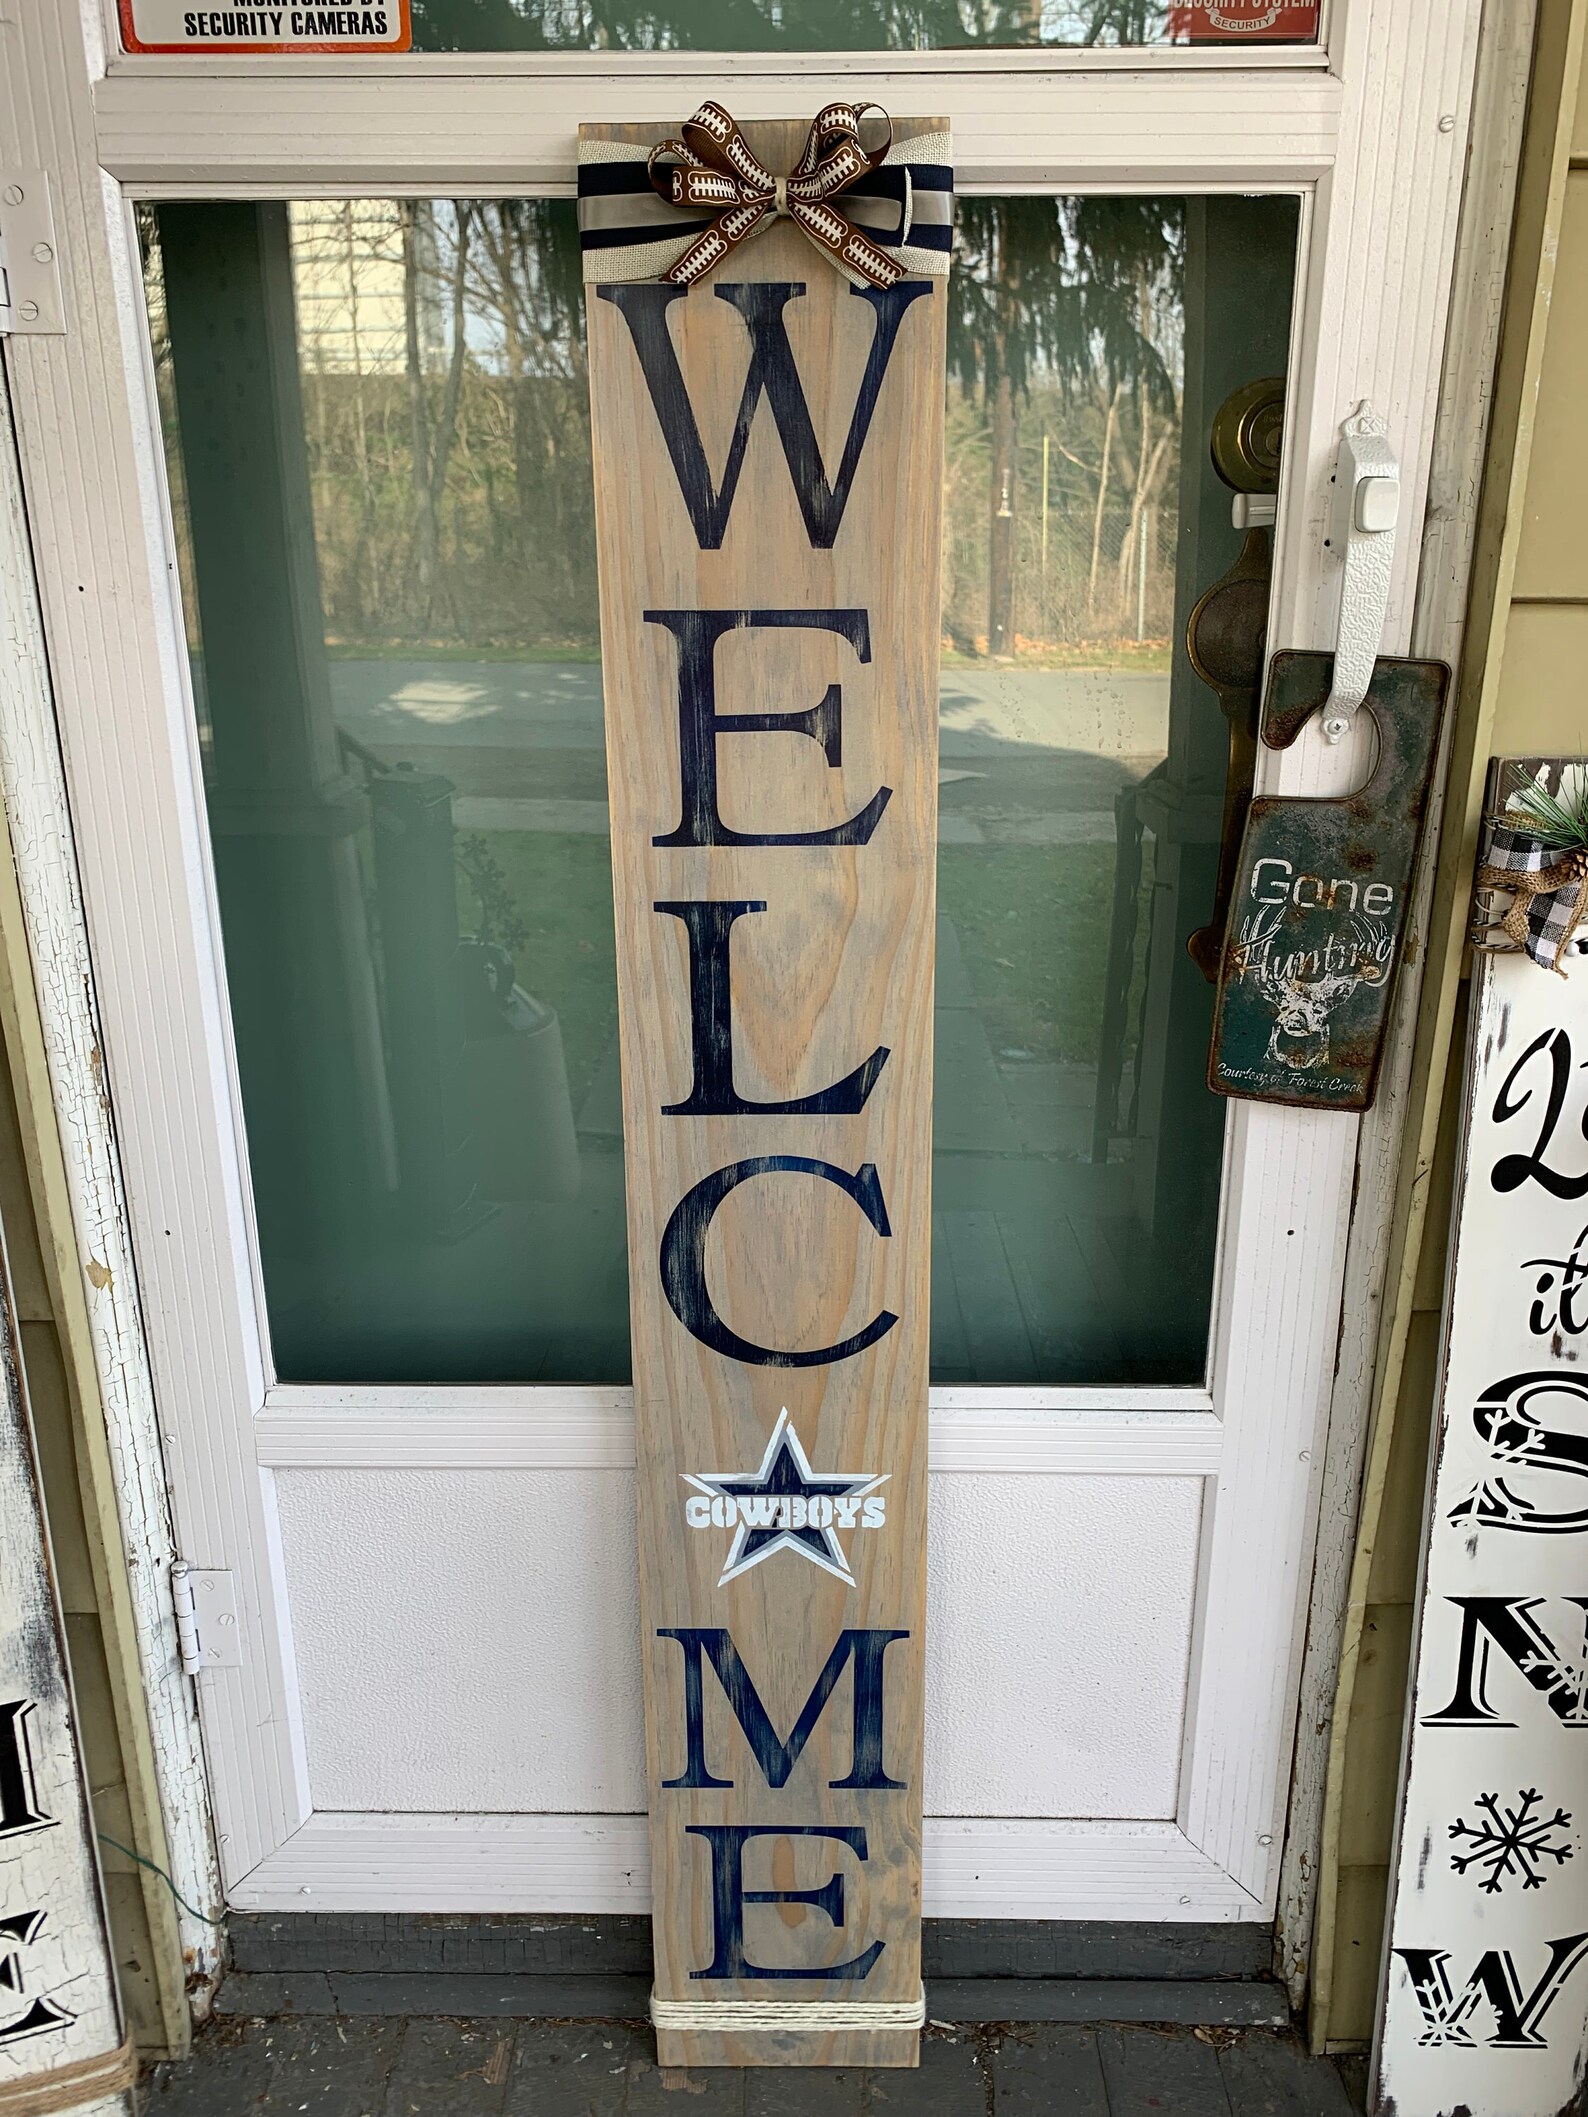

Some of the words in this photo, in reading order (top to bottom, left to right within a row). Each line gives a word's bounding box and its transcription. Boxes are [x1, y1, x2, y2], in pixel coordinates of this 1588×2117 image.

[184, 12, 282, 36] SECURITY
[291, 11, 388, 35] CAMERAS
[1214, 16, 1271, 30] SECURITY
[1250, 858, 1394, 916] Gone
[1217, 1062, 1268, 1087] Courtesy
[685, 1496, 886, 1529] COWBOYS
